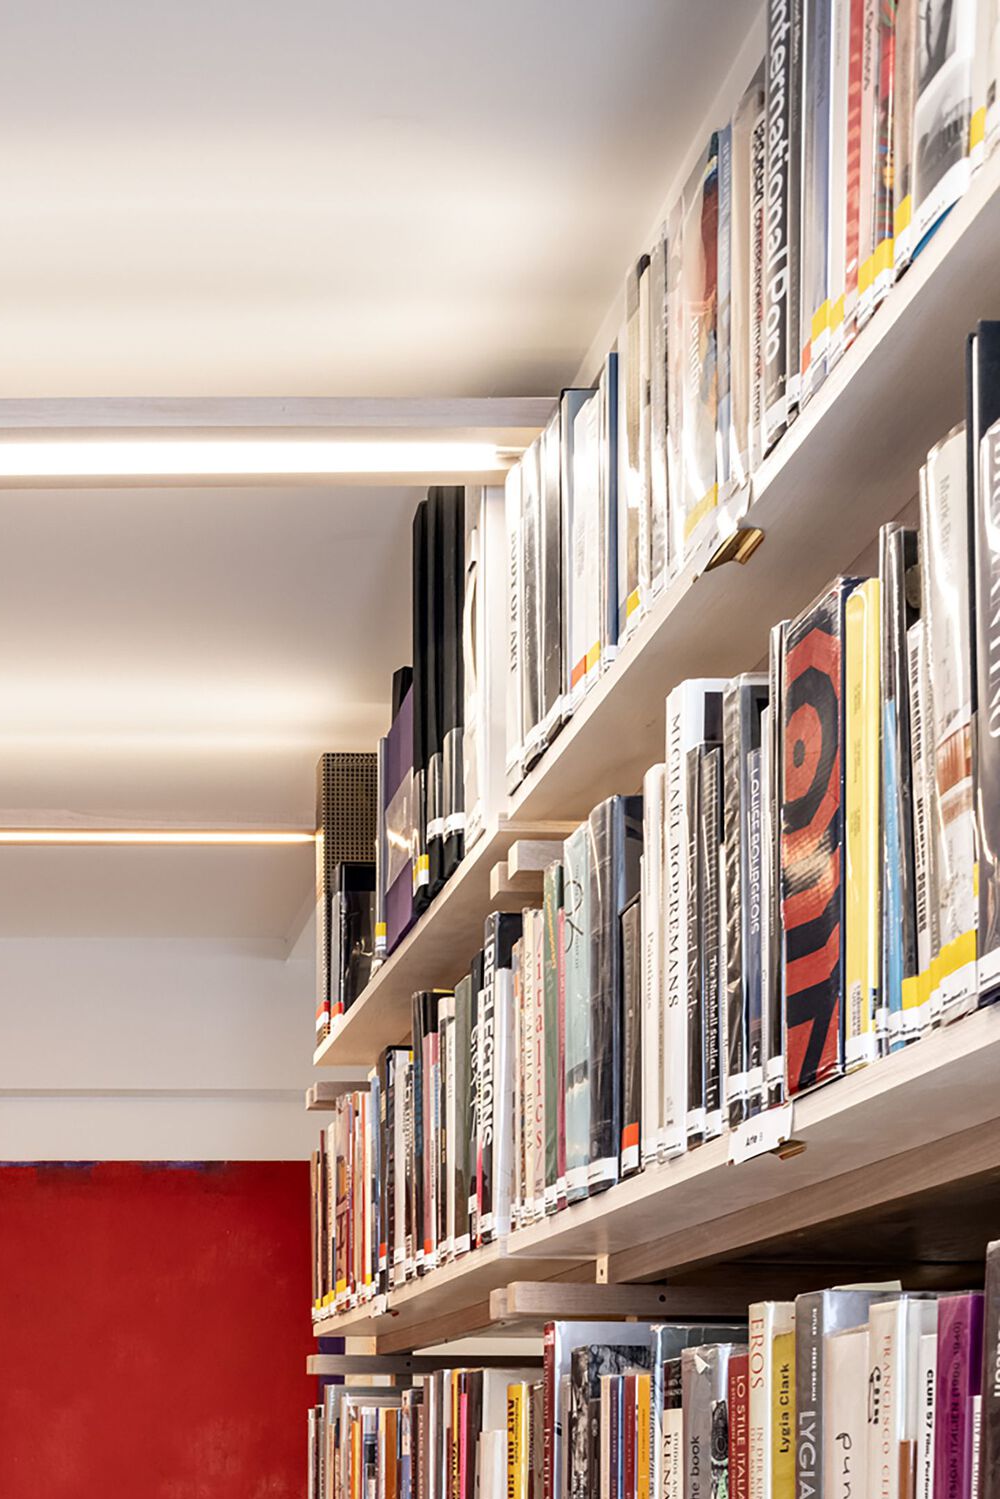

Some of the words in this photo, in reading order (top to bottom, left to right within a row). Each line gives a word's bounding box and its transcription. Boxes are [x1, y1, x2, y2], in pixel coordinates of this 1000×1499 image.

[509, 533, 518, 590] BODY
[509, 594, 518, 620] OF
[509, 631, 518, 673] ART
[669, 713, 684, 837] MICHAËL
[750, 767, 760, 829] LOUISE
[749, 832, 761, 934] BOURGEOIS
[917, 871, 927, 934] POSTERS
[667, 844, 681, 1009] BORREMANS
[646, 930, 655, 1011] Paintings
[709, 955, 718, 978] The
[687, 958, 698, 1019] Nude
[709, 979, 718, 1029] Nutshell
[710, 1032, 718, 1070] Studies
[525, 1092, 535, 1150] RUSSA
[810, 1307, 818, 1336] BUTLER
[750, 1318, 766, 1390] EROS
[736, 1374, 746, 1398] LO
[777, 1363, 791, 1406] Clark
[881, 1335, 892, 1456] FRANCESCO
[926, 1369, 935, 1407] CLUB
[507, 1399, 515, 1434] ART
[736, 1404, 746, 1447] STILE
[777, 1413, 792, 1454] Lygia
[926, 1411, 935, 1430] 57
[671, 1432, 679, 1475] STUDIOS
[688, 1436, 701, 1478] book
[754, 1444, 764, 1469] DER
